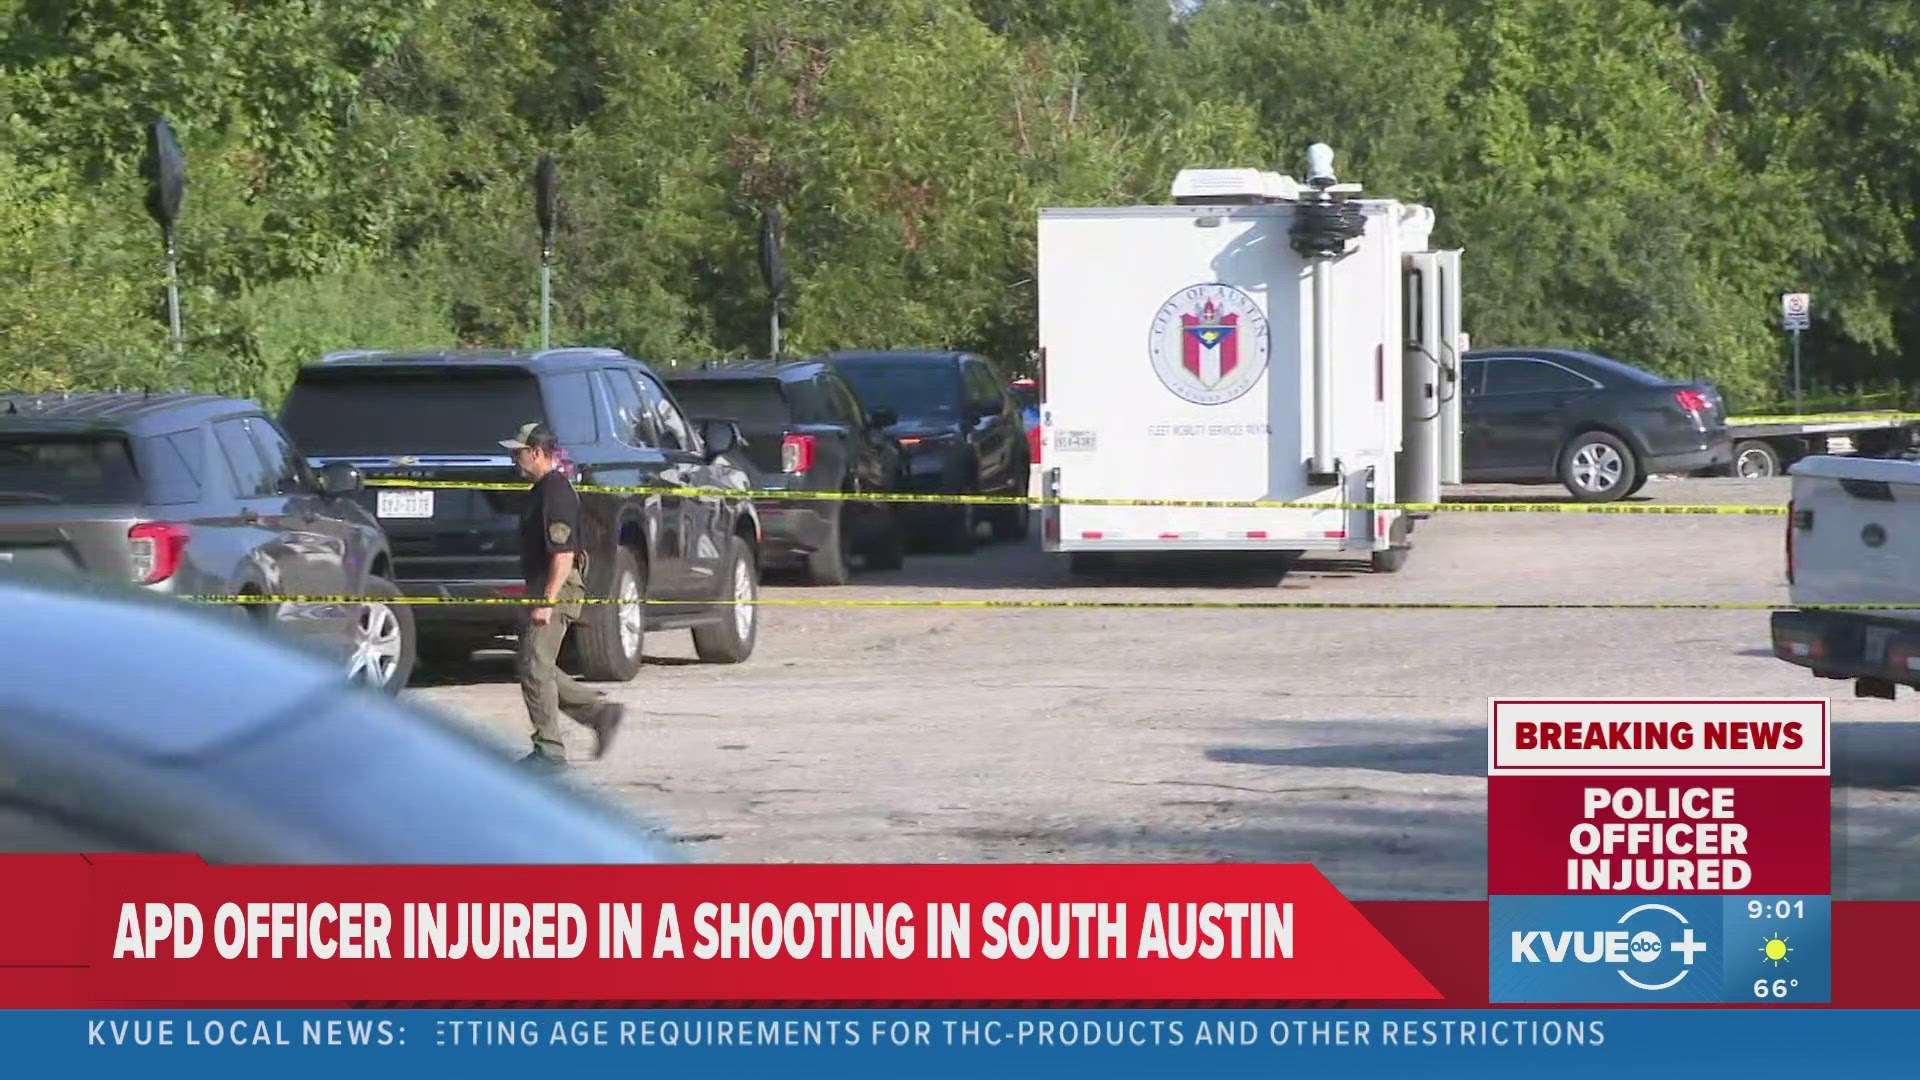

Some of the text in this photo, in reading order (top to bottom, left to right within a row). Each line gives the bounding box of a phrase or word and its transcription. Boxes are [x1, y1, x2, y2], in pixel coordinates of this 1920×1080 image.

[1154, 286, 1269, 338] CITY OF AUSTIN
